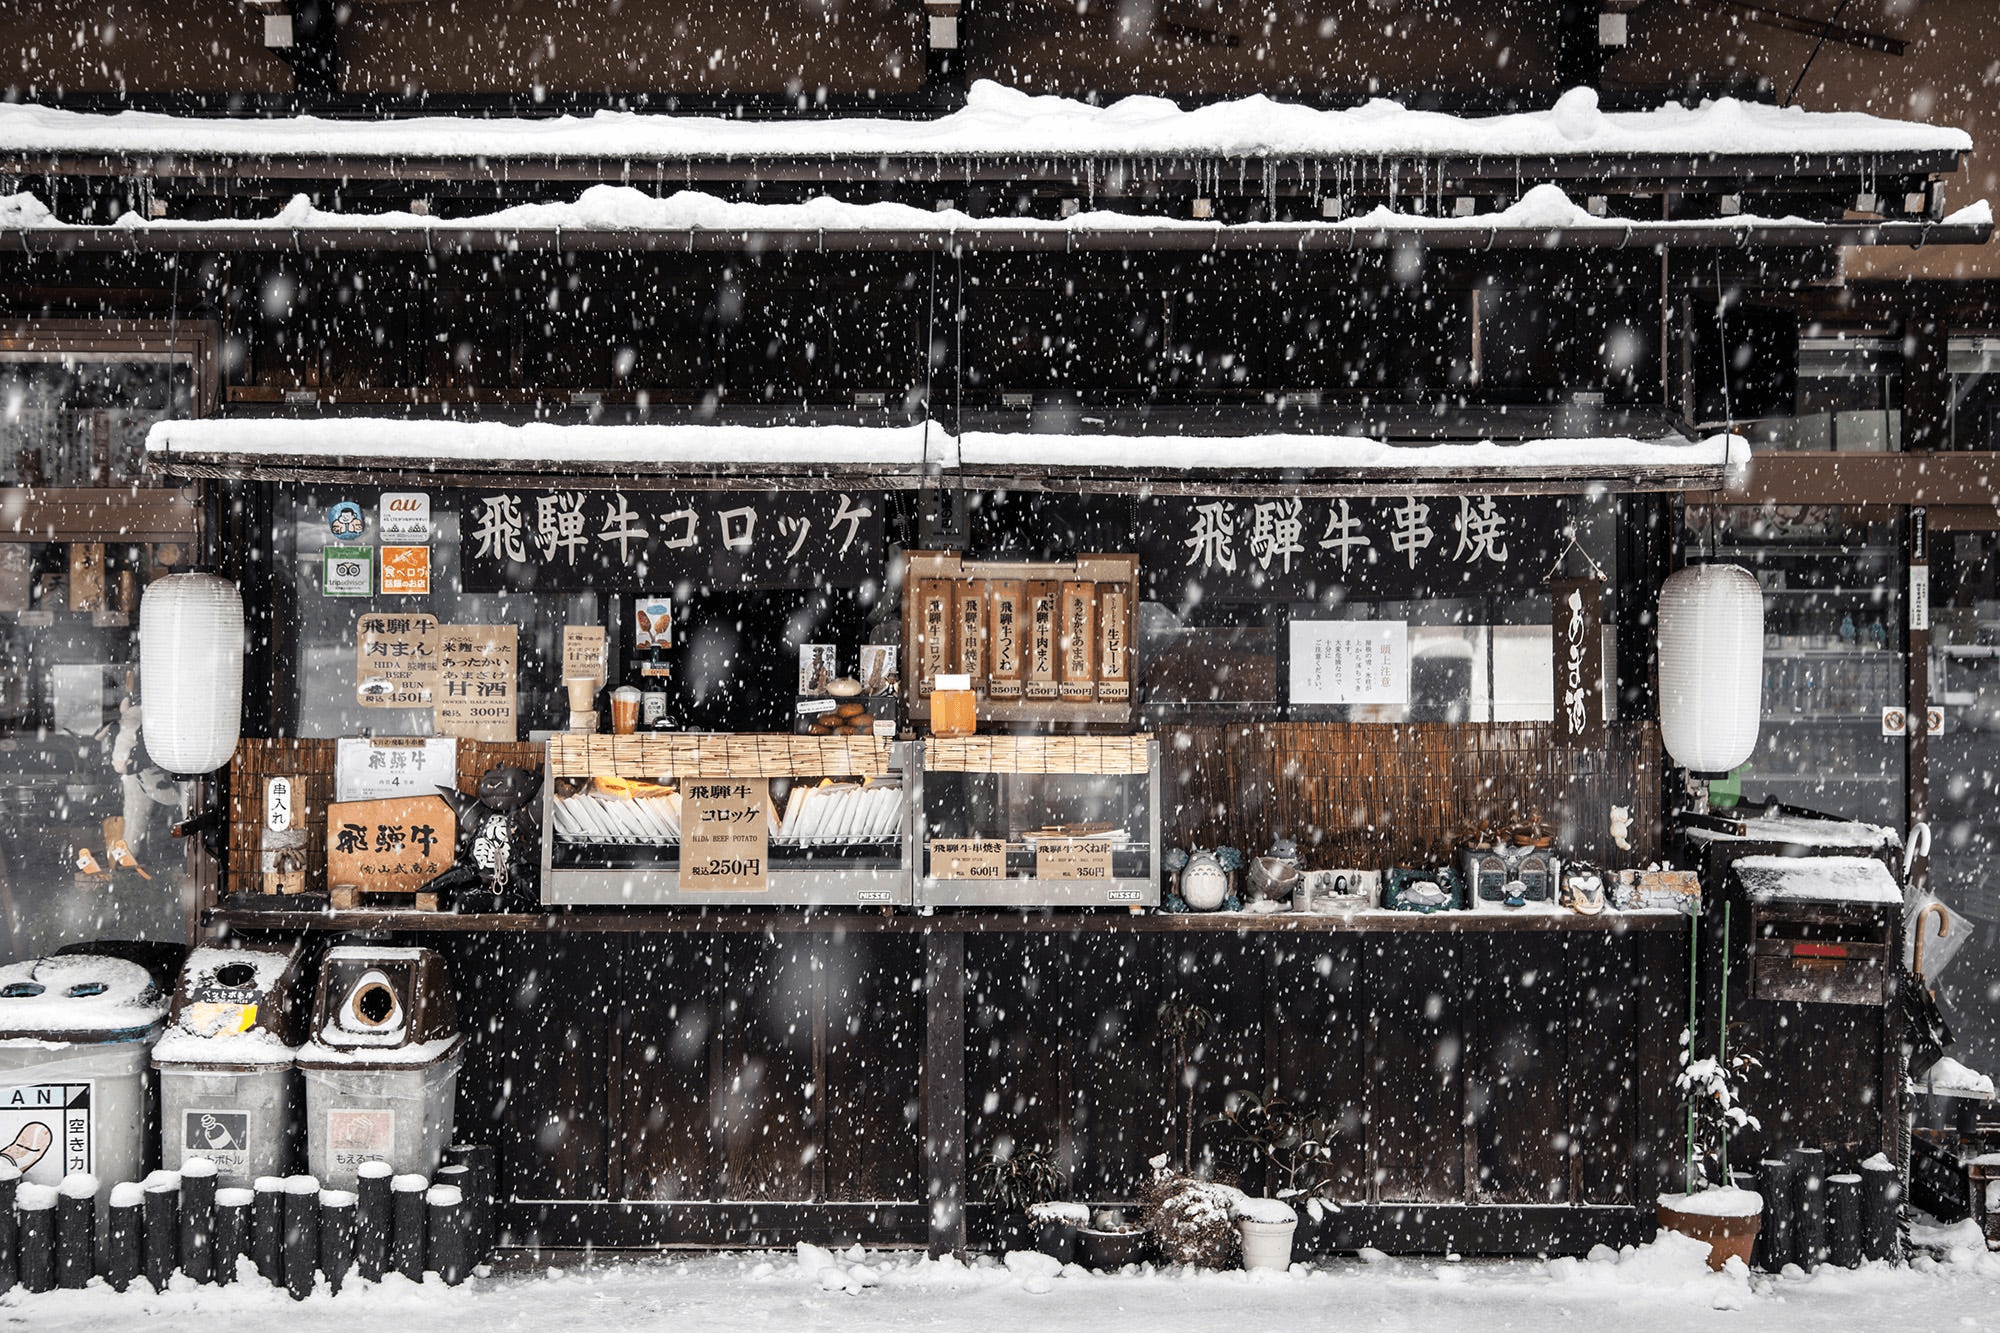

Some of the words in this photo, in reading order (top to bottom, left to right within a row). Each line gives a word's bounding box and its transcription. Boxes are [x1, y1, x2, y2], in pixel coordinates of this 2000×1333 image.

[390, 499, 421, 511] au
[472, 492, 873, 566] 飛騨牛コロッケ
[1184, 495, 1508, 574] 飛騨牛串焼
[362, 619, 435, 634] 飛騨牛
[929, 600, 941, 674] 飛騨牛コロッケ
[965, 600, 978, 673] 飛騨牛串焼き
[1000, 601, 1013, 671] 飛騨牛つくね
[1036, 600, 1049, 673] 飛騨牛肉まん
[366, 641, 433, 656] 肉まん
[374, 661, 401, 669] HIDA
[442, 658, 510, 667] あったかい
[386, 671, 412, 679] BEEF
[402, 681, 424, 689] BUN
[443, 681, 507, 697] 甘酒
[1100, 688, 1128, 696] 550円
[470, 707, 509, 718] 300円
[368, 750, 426, 771] 飛騨牛
[689, 785, 752, 799] 飛騨牛
[272, 783, 287, 824] 串入れ
[702, 807, 760, 824] コロッケ
[336, 823, 438, 857] 飛騨牛
[693, 835, 709, 843] HIDA
[713, 835, 729, 843] BEEF
[733, 835, 758, 843] POTATO
[934, 842, 1002, 853] 飛騨牛串焼き
[970, 866, 999, 877] 600円
[1076, 866, 1105, 877] 350円
[202, 990, 254, 999] ペットボトル
